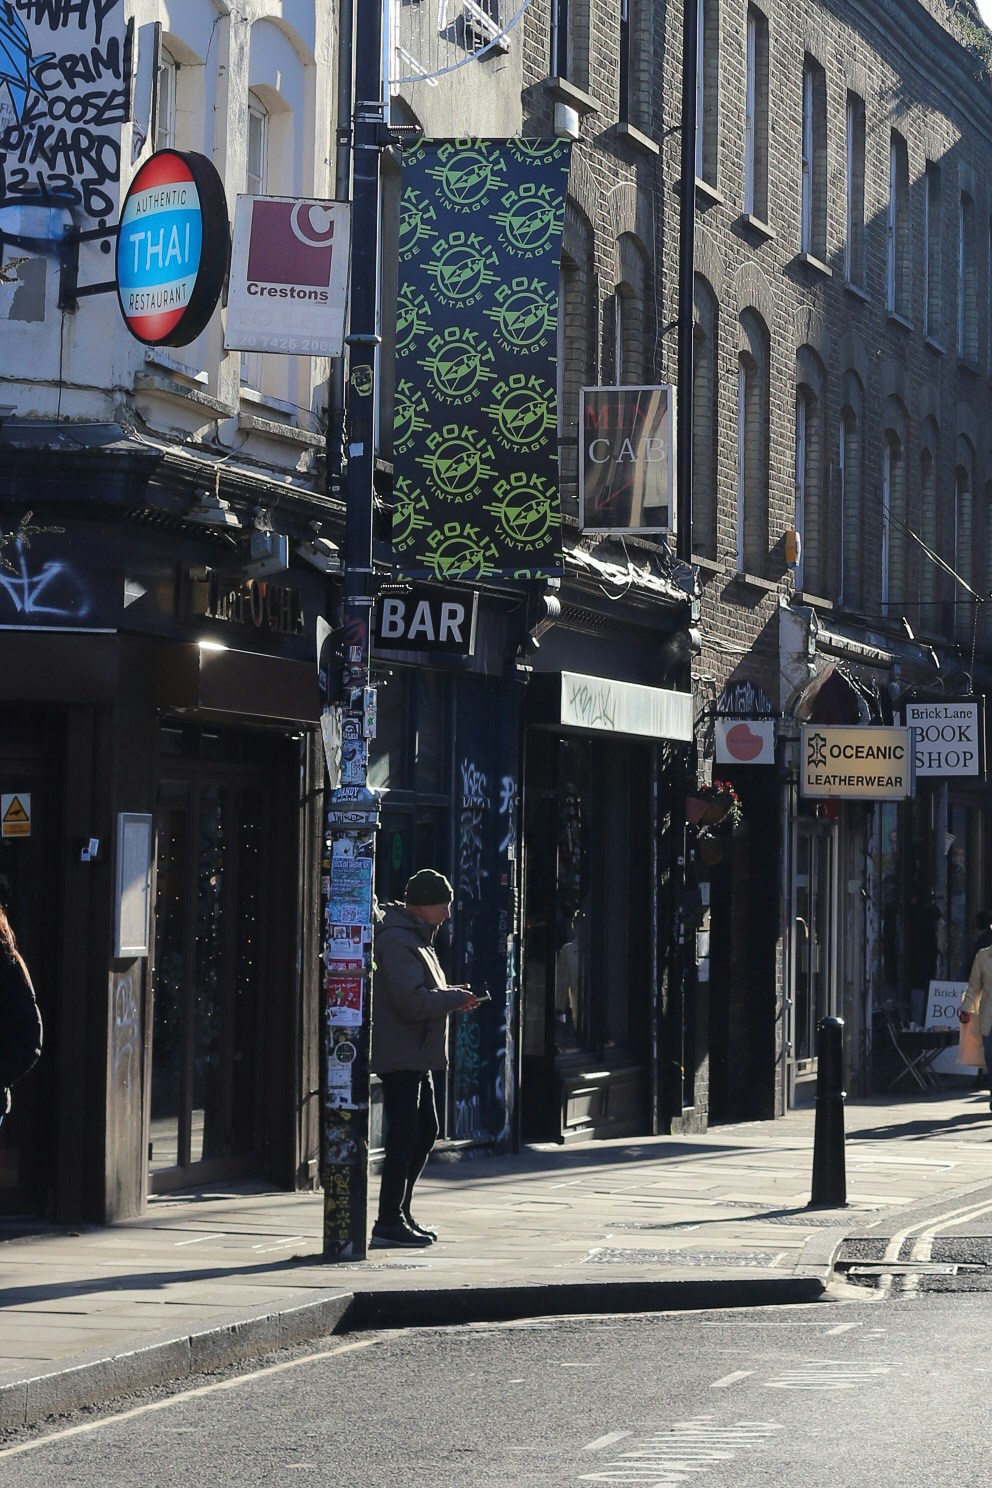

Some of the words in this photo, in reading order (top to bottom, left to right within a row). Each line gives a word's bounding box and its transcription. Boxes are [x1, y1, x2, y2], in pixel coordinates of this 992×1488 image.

[22, 89, 128, 126] LOOSE
[437, 138, 507, 171] ROKIT
[506, 139, 561, 166] VINTAGE
[136, 190, 187, 215] AUTHENTIC
[435, 188, 489, 213] VINTAGE
[130, 223, 190, 273] THAI
[431, 231, 499, 265] ROKIT
[497, 233, 553, 259] VINTAGE
[129, 283, 187, 310] RESTAURANT
[247, 283, 328, 301] Crestons
[429, 283, 484, 309] VINTAGE
[427, 327, 496, 362] ROKIT
[493, 328, 548, 355] VINTAGE
[426, 379, 480, 406] VINTAGE
[426, 424, 496, 460] ROKIT
[492, 426, 548, 453] VINTAGE
[589, 438, 665, 463] CAB
[426, 477, 482, 504] VINTAGE
[426, 522, 499, 558] ROKIT
[495, 524, 552, 552] VINTAGE
[381, 598, 465, 643] BAR
[911, 708, 941, 720] Brick
[944, 707, 973, 719] Lane
[915, 725, 973, 743] BOOK
[829, 744, 904, 761] OCEANIC
[915, 750, 974, 769] SHOP
[807, 775, 903, 787] LEATHERWEAR
[934, 988, 958, 998] Brick
